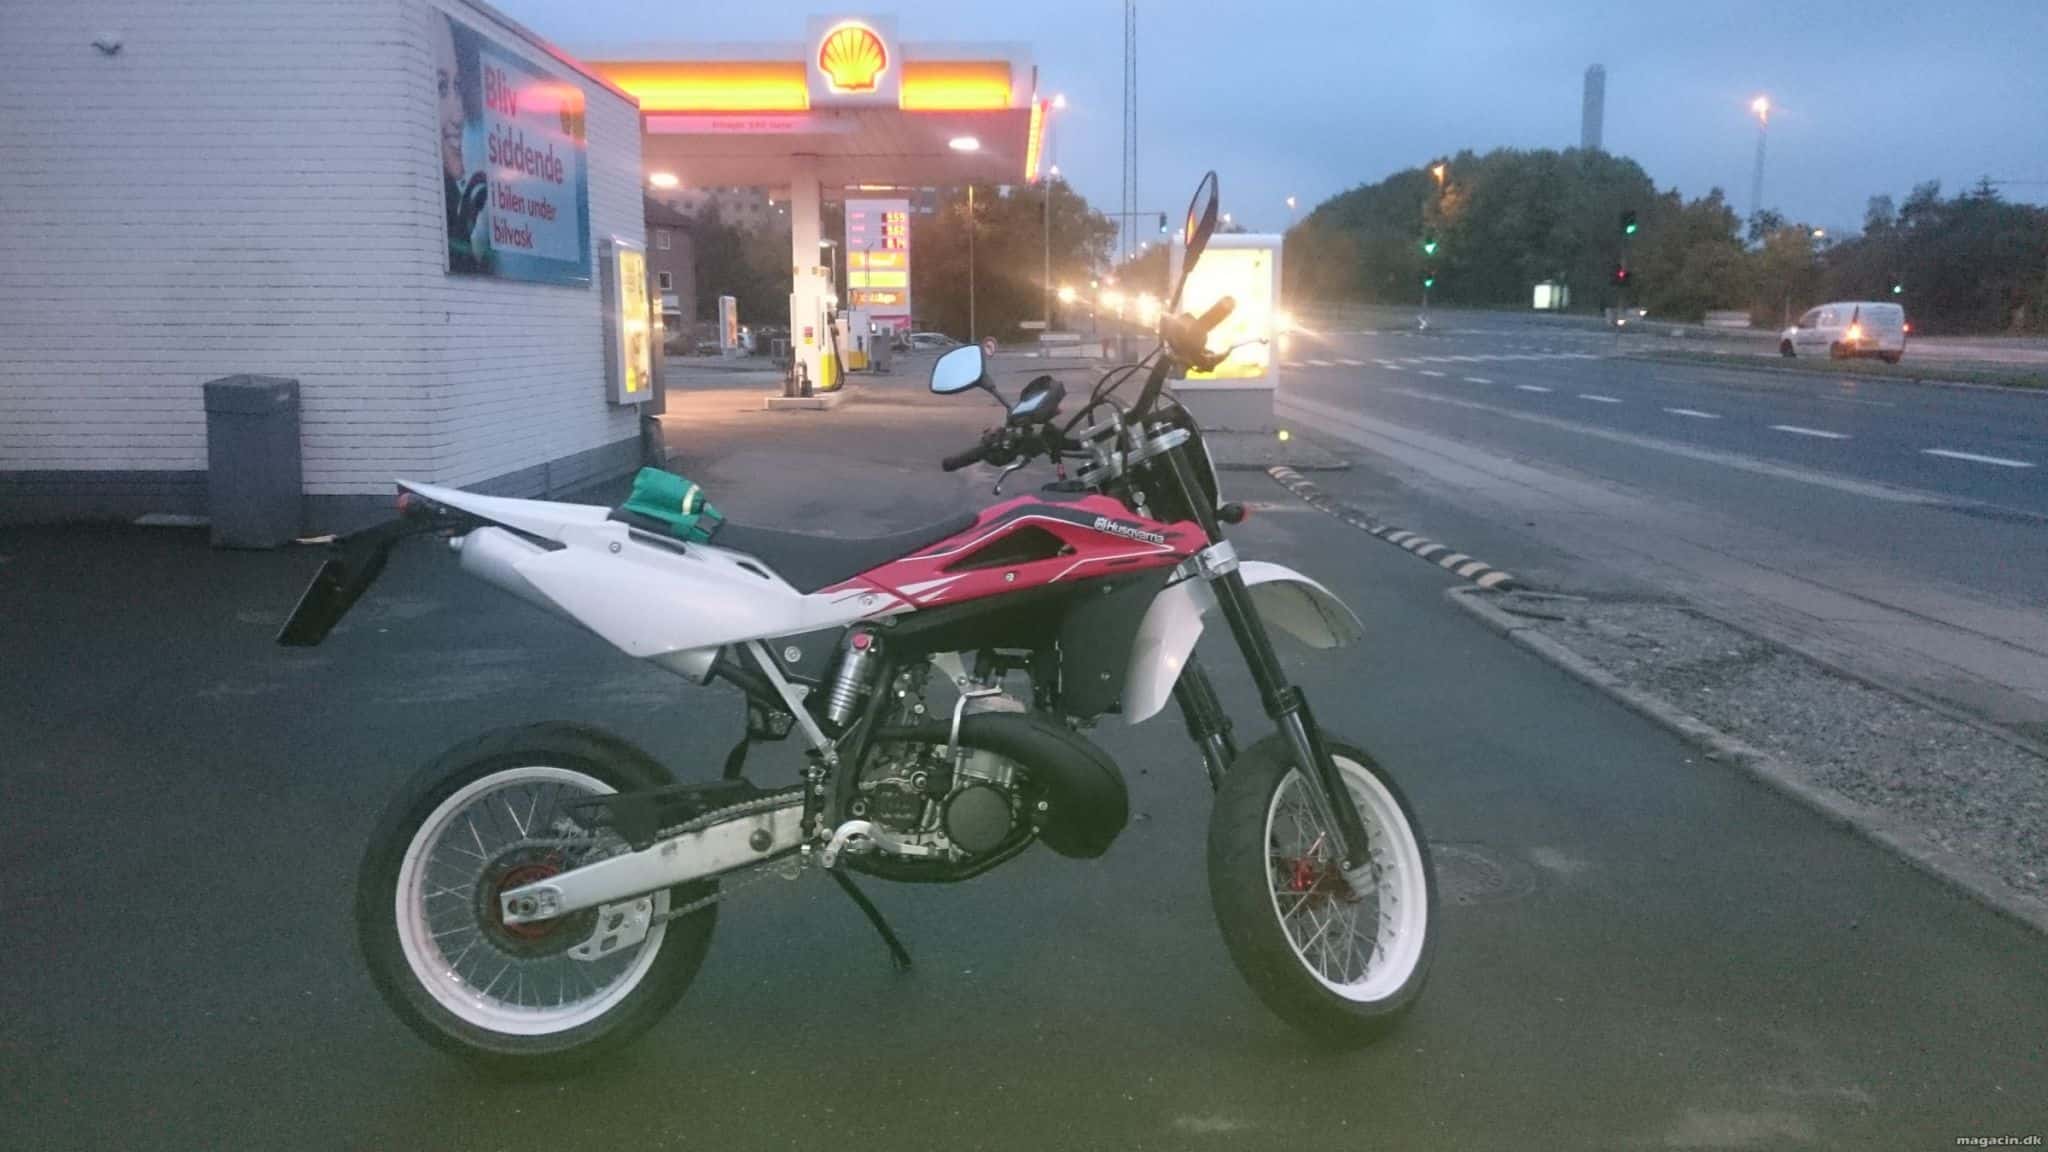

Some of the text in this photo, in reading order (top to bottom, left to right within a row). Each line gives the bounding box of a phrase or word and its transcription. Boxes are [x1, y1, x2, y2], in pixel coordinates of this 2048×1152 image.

[484, 66, 517, 117] Bliv
[488, 124, 563, 185] siddende
[499, 184, 525, 214] bilen
[527, 198, 556, 222] under
[493, 216, 533, 249] bilvask
